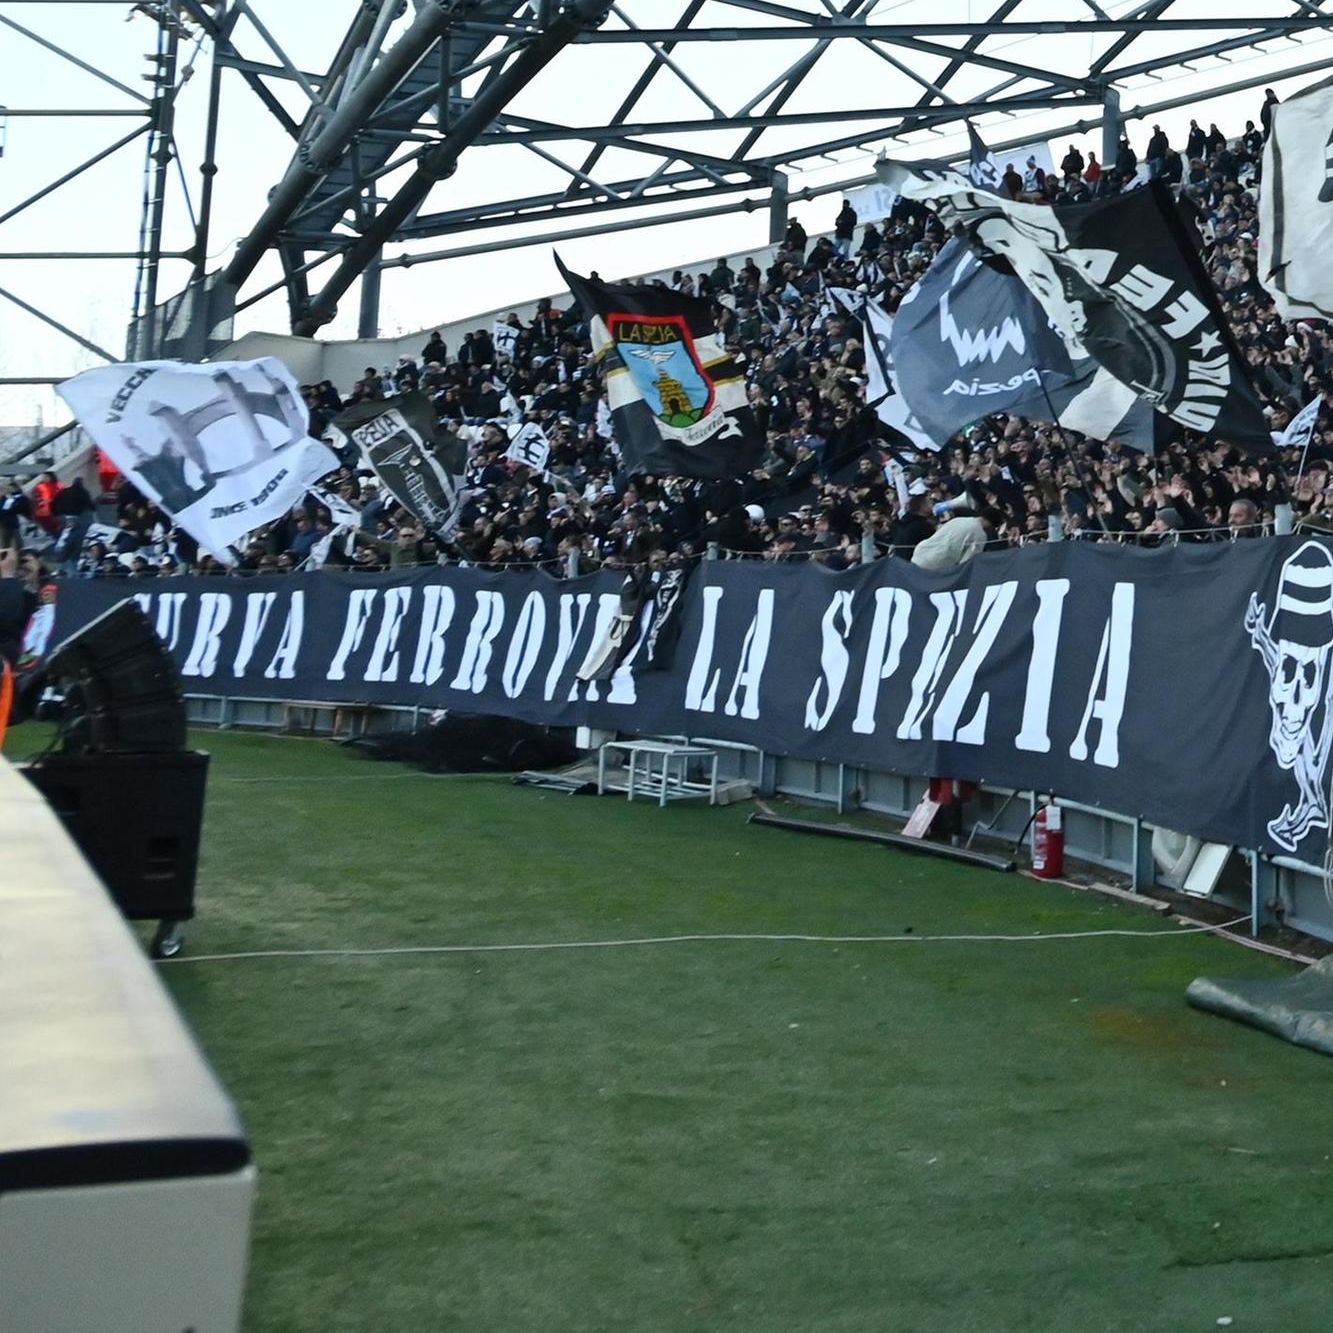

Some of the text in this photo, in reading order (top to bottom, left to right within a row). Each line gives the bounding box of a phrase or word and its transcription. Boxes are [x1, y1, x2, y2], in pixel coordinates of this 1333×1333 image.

[133, 589, 305, 680] URVA
[684, 578, 1136, 769] LA SPEZIA
